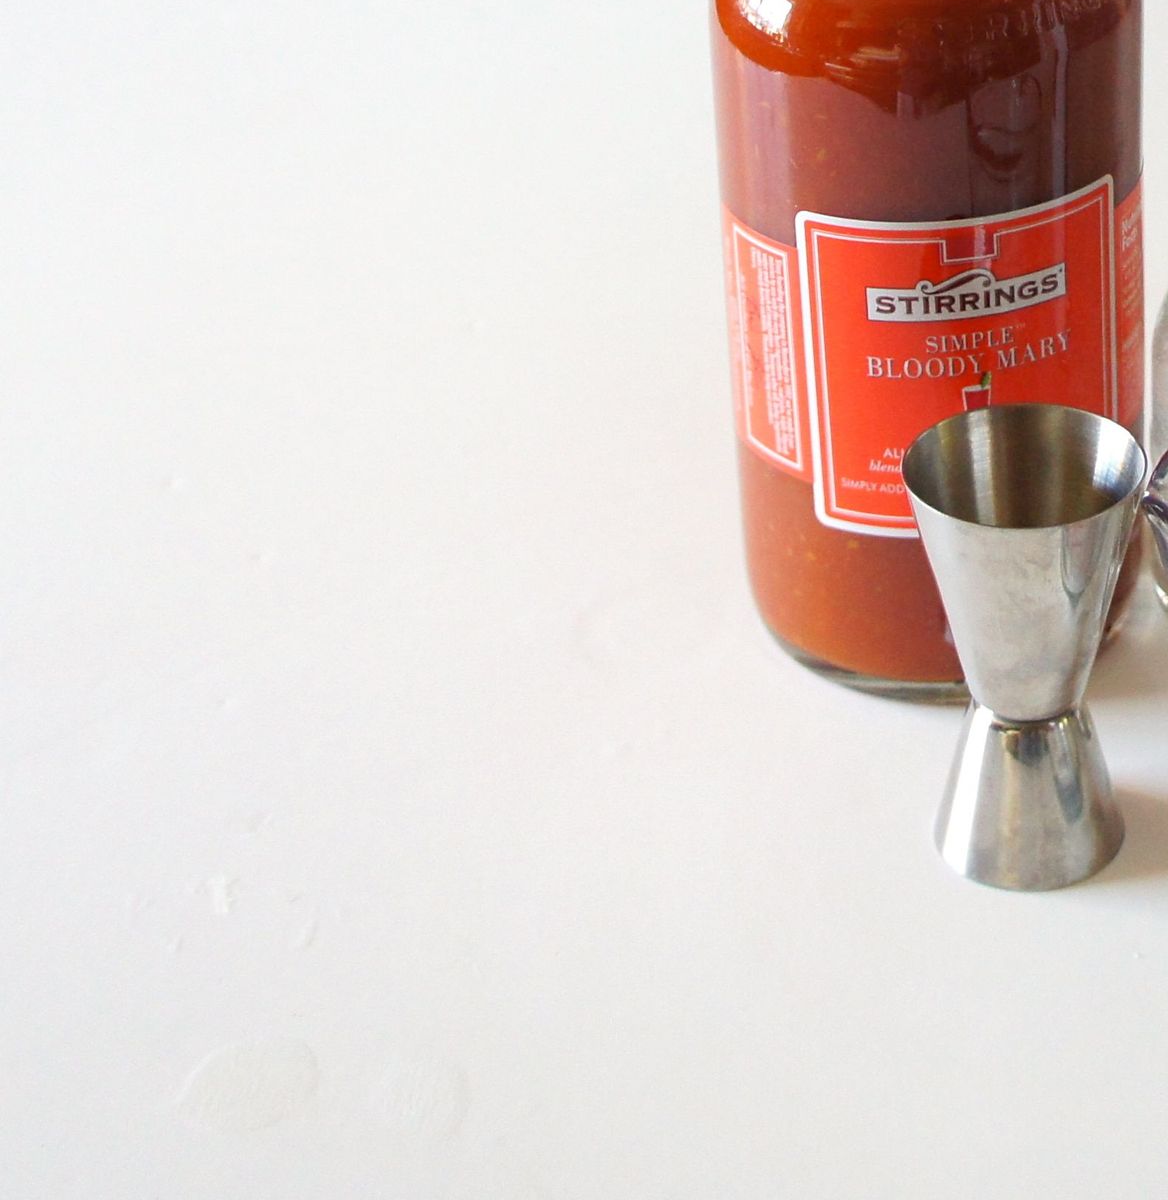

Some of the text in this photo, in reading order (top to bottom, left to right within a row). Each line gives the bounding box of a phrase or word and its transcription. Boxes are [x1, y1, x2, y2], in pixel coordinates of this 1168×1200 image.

[875, 278, 1060, 314] STIRRINGS
[867, 329, 1072, 380] BLOODY MARY
[925, 326, 1014, 355] SIMPLE
[840, 477, 877, 492] SIMPLY
